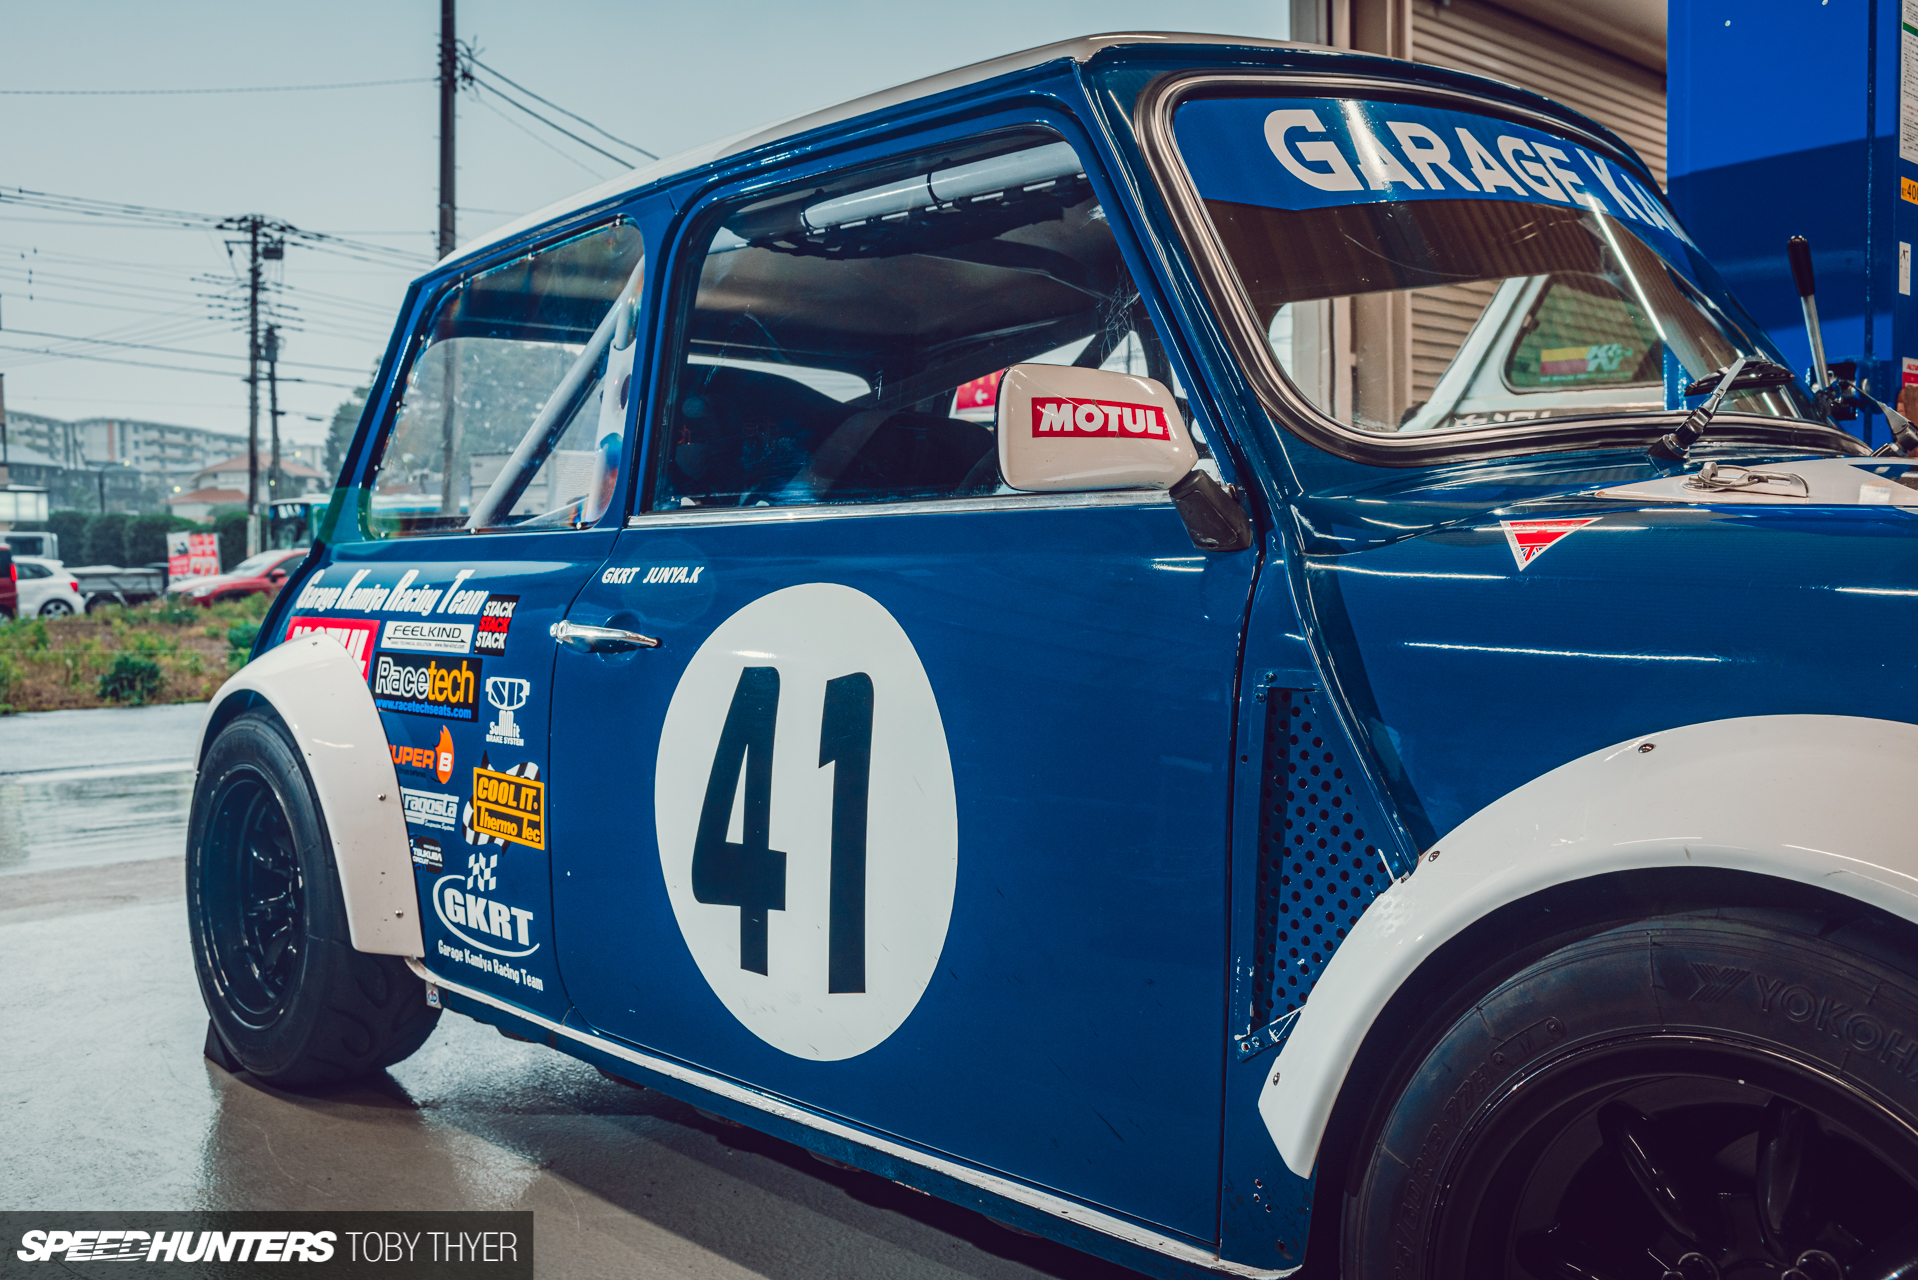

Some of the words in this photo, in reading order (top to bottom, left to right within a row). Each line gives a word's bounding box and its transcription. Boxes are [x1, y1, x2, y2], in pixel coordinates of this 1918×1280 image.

[1264, 109, 1608, 212] GARAGE
[1039, 403, 1164, 435] MOTUL
[601, 567, 640, 584] GKRT
[642, 567, 704, 583] JUNYA.K
[296, 569, 342, 612] Garage
[382, 569, 443, 616] Racing
[436, 569, 489, 615] Team
[483, 601, 516, 617] STACK
[393, 625, 462, 639] FEELKIND
[478, 616, 511, 633] STACK
[475, 631, 507, 649] STACK
[375, 656, 474, 704] Racetech
[375, 698, 472, 719] www.racetechseats.com
[486, 733, 503, 743] BRAKE
[503, 736, 524, 746] SYSTEM
[389, 744, 435, 769] UPER
[438, 752, 452, 772] B
[404, 795, 458, 818] ragosta
[477, 777, 517, 808] COOL
[477, 800, 518, 836] Thermo
[519, 812, 541, 843] Tec
[691, 666, 875, 994] 41
[443, 888, 533, 946] GKRT
[438, 940, 463, 962] Garage
[464, 949, 492, 972] Kamiya
[493, 959, 520, 984] Racing
[520, 968, 543, 991] Team
